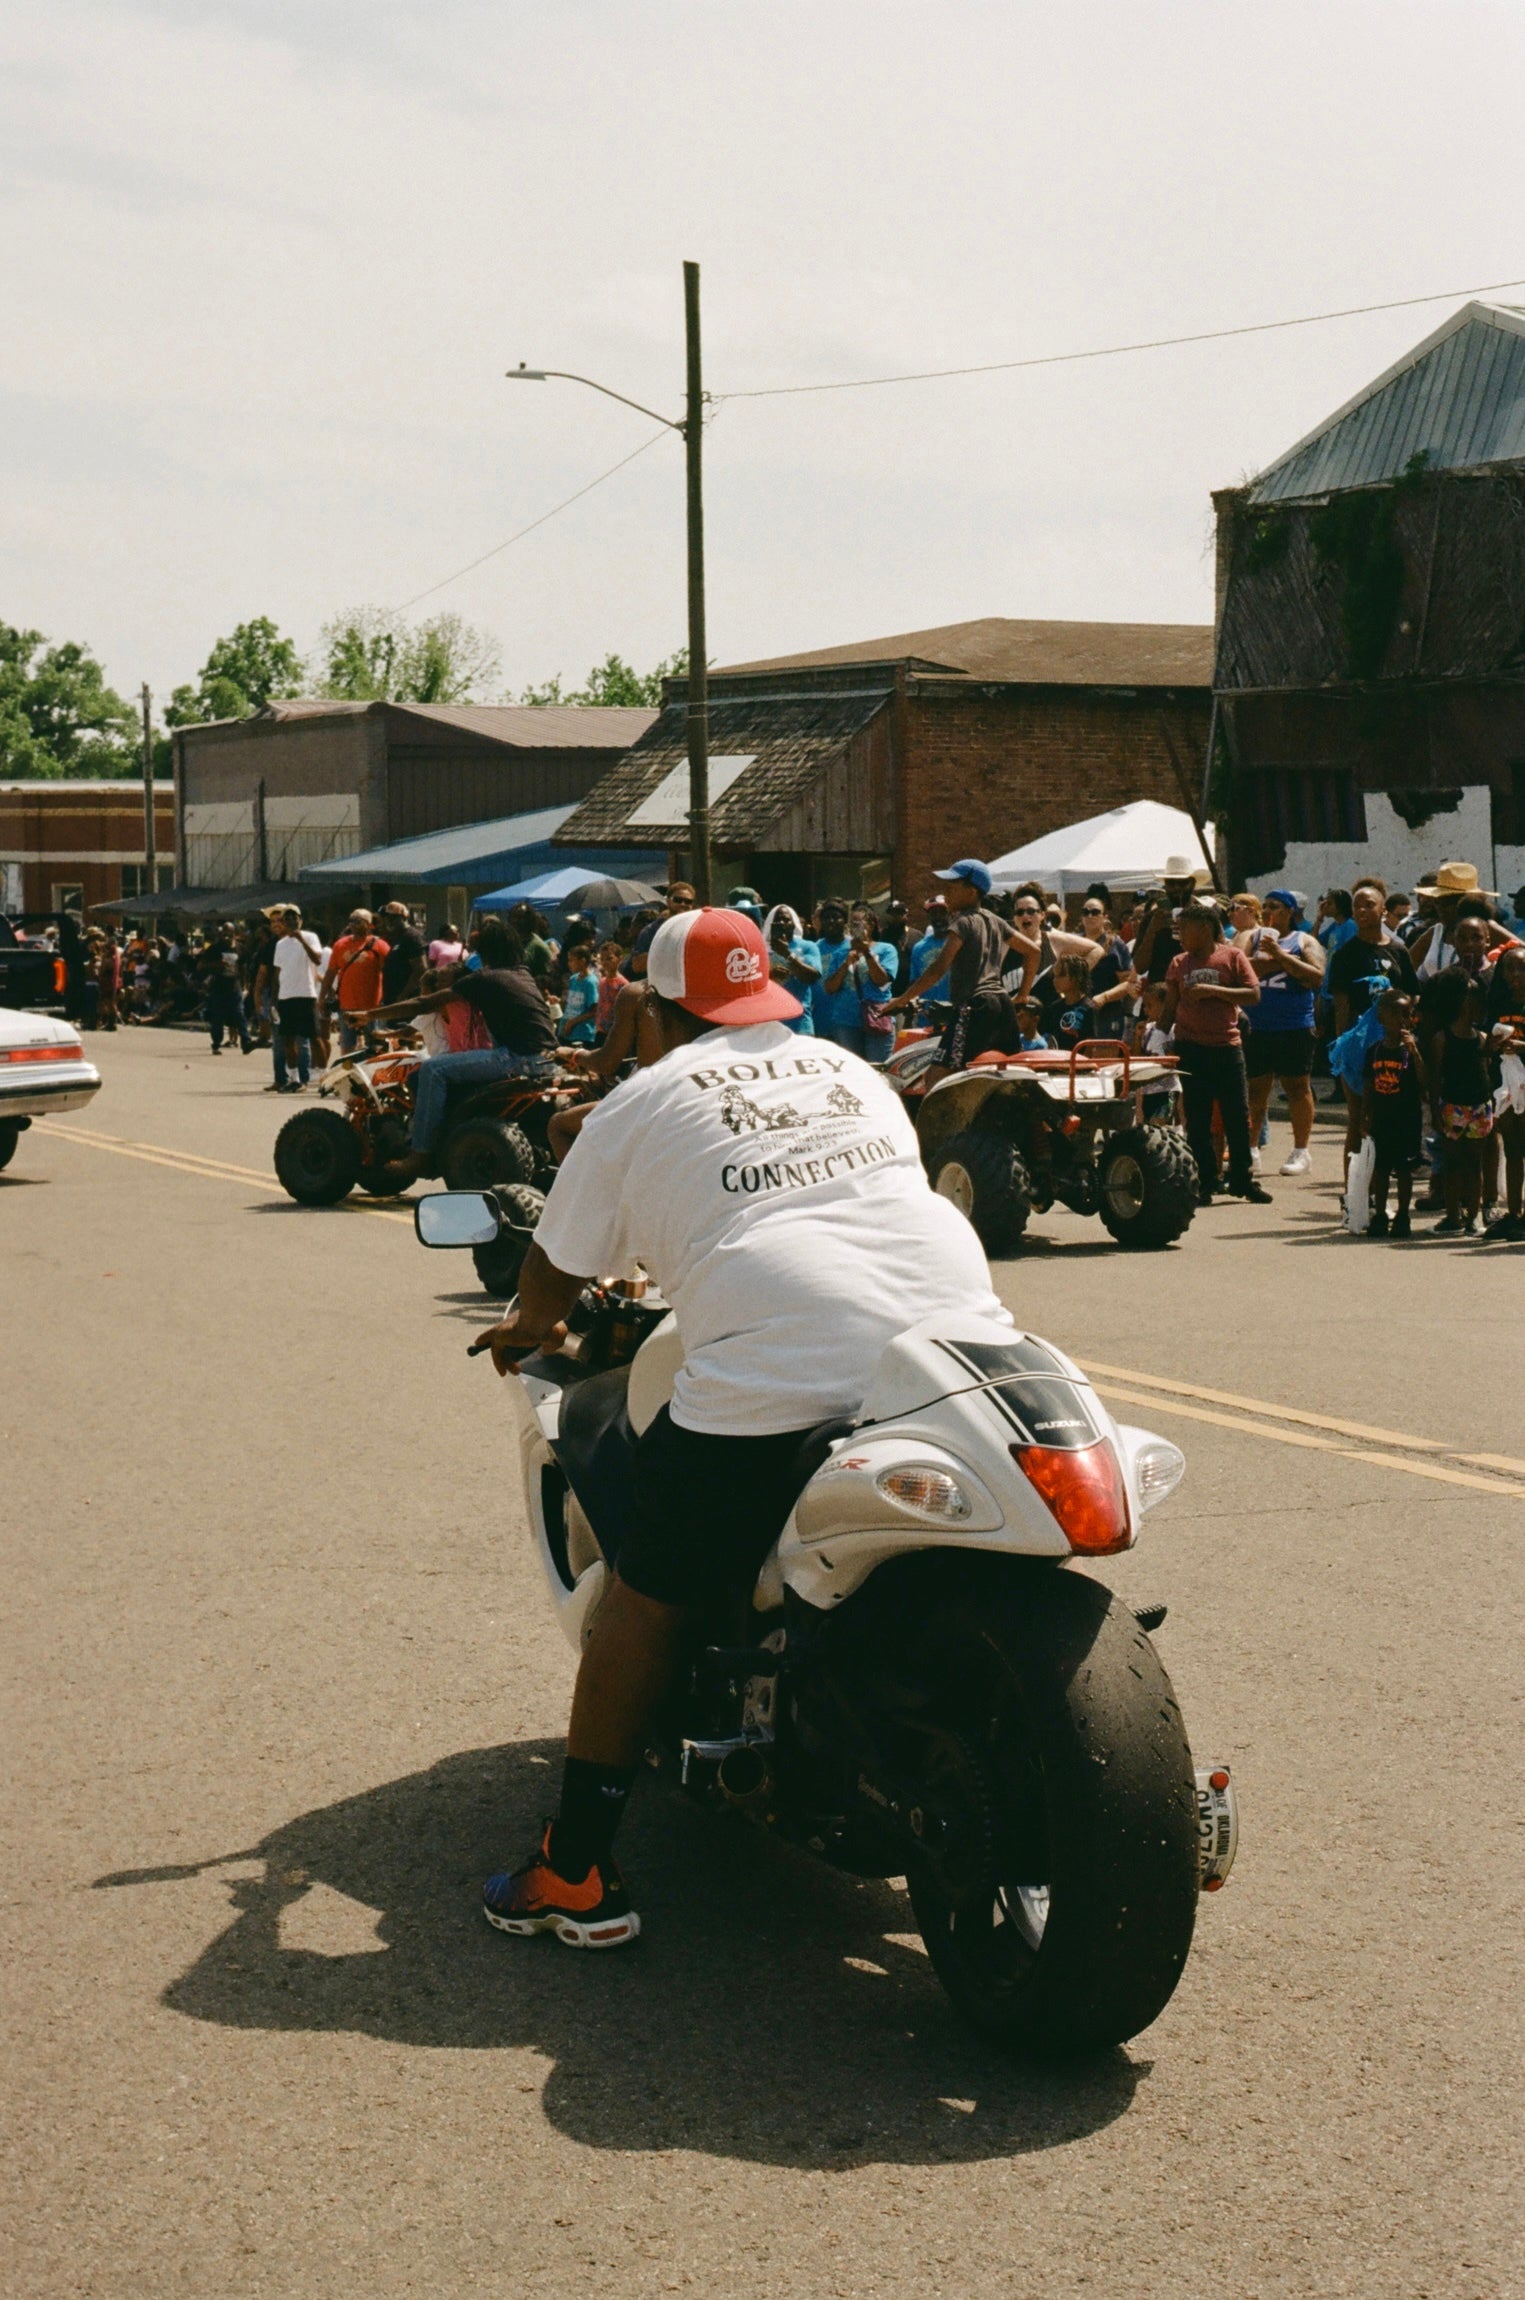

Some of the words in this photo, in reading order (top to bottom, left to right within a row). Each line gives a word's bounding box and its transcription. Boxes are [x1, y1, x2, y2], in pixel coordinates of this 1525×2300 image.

[687, 1057, 847, 1090] BOLEY
[721, 1135, 897, 1193] CONNECTION
[788, 1145, 812, 1155] Mark
[1034, 1420, 1087, 1430] SUZUKI
[1216, 1815, 1230, 1856] OKLAHOMA
